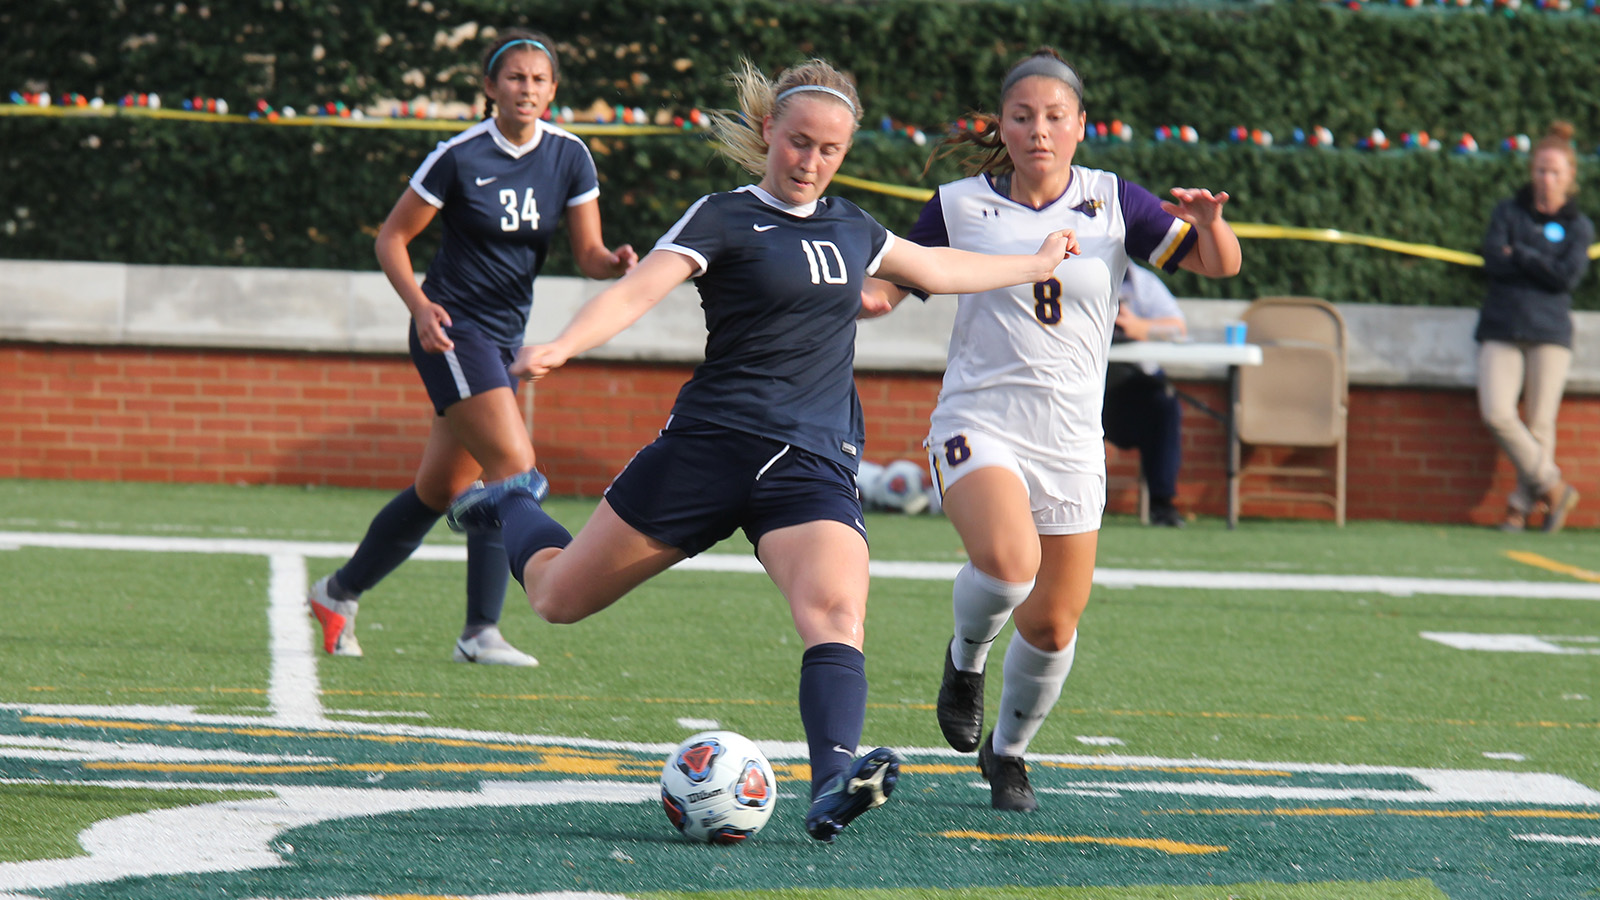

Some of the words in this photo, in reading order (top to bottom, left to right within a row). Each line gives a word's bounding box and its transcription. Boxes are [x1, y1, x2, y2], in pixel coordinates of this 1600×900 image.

[499, 187, 541, 232] 34
[801, 239, 848, 285] 10
[1033, 276, 1063, 326] 8
[943, 433, 972, 468] 8
